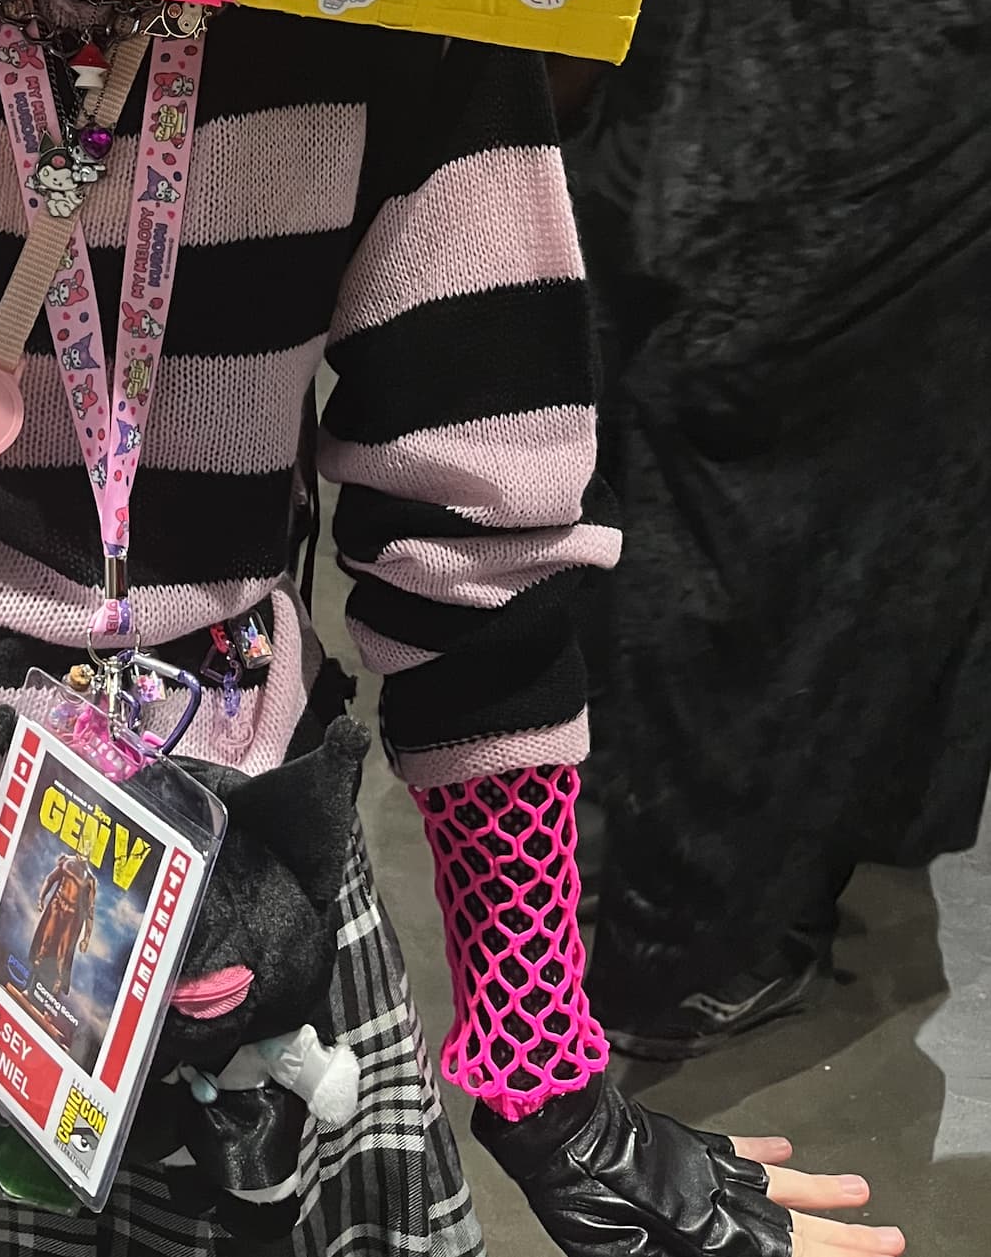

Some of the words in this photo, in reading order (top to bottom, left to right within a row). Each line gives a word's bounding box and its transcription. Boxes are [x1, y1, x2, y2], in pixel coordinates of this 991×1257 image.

[25, 75, 42, 99] MY
[14, 91, 39, 154] KUROMI
[133, 206, 155, 273] MELODY
[148, 222, 168, 288] KUROMI
[131, 273, 146, 299] MY
[39, 786, 112, 870] GEN
[112, 822, 152, 892] V
[131, 853, 187, 1002] ATTENDEE
[35, 981, 62, 1011] Coming
[60, 1005, 79, 1027] Soon
[57, 1086, 84, 1145] COMIC
[79, 1098, 108, 1135] CON
